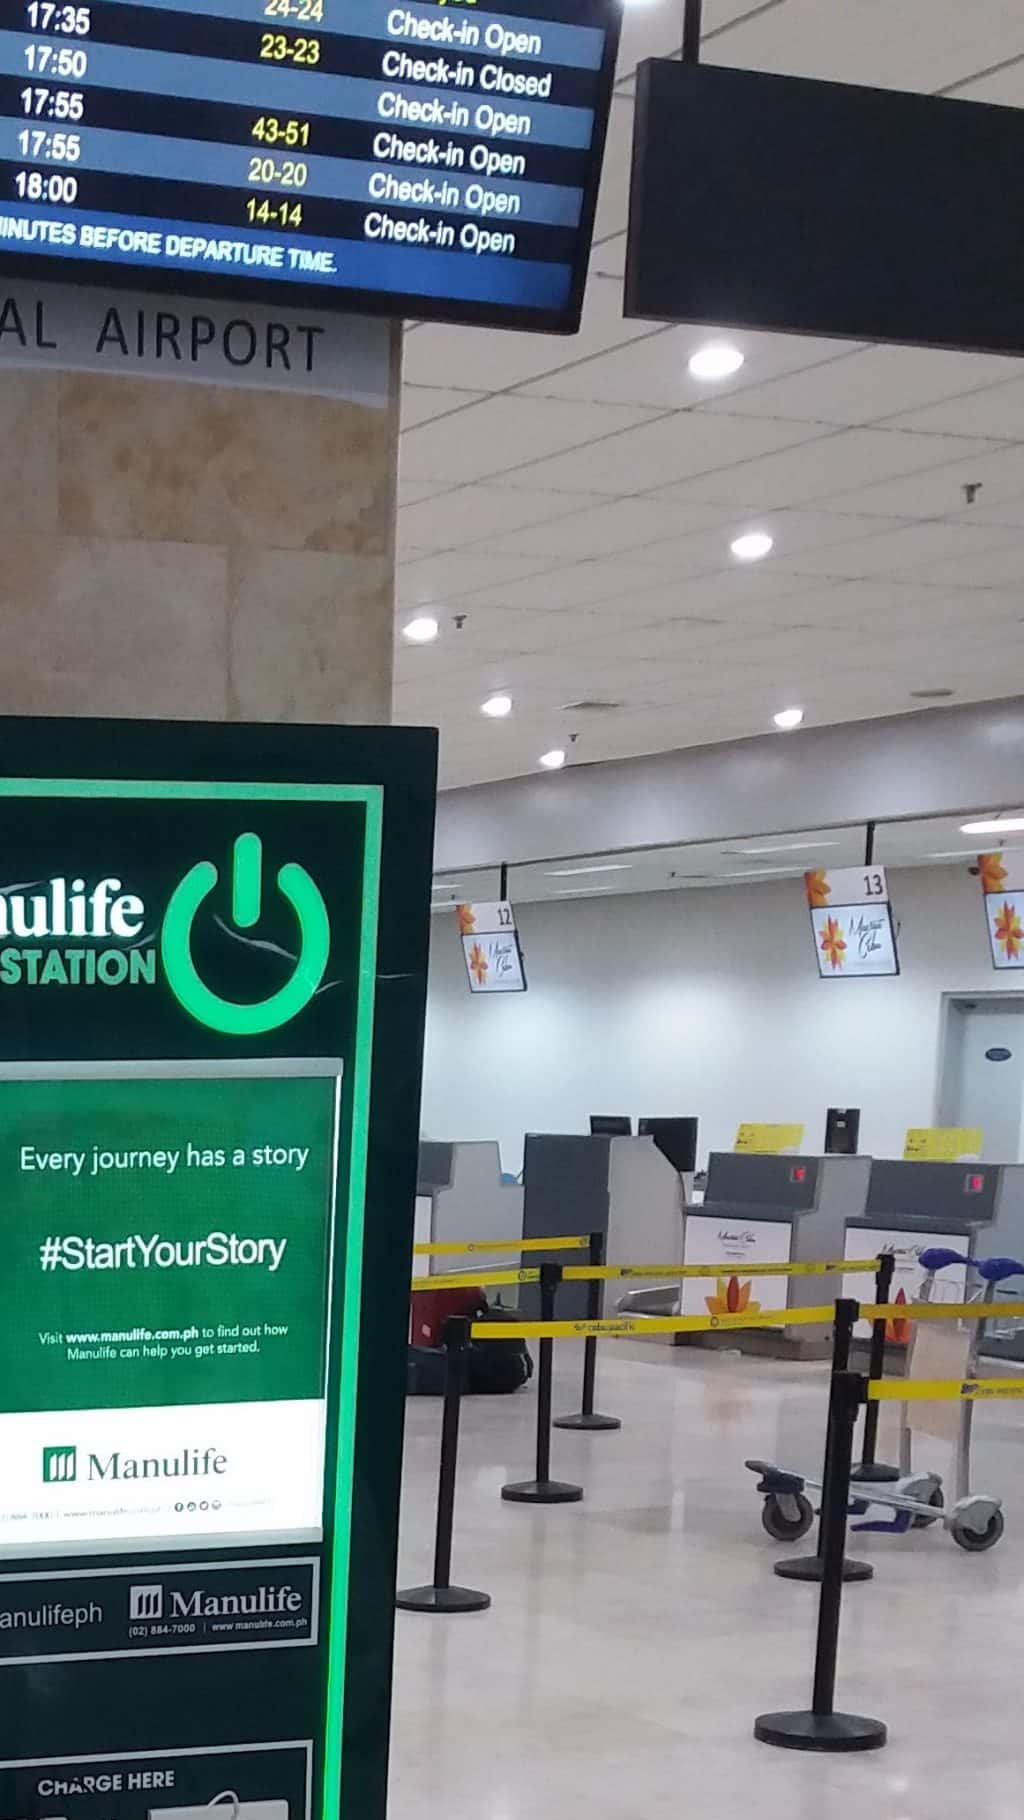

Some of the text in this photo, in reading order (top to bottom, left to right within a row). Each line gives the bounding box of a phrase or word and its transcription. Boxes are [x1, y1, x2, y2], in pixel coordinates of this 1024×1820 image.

[264, 0, 542, 56] 24-24 Check-in Open
[27, 1, 553, 98] 17:35 23-23 Check-in Closed
[24, 43, 87, 79] 17:50
[377, 91, 469, 127] Check-in
[475, 104, 532, 136] Open
[20, 86, 85, 121] 17:55
[251, 116, 310, 147] 43-51
[372, 132, 465, 167] Check-in
[469, 144, 526, 176] Open
[18, 128, 81, 162] 17:55
[247, 156, 308, 188] 20-20
[368, 172, 460, 207] Check-in
[464, 184, 521, 216] Open
[14, 170, 78, 204] 18:00
[245, 197, 303, 227] 14-14
[363, 212, 455, 246] Check-in
[459, 223, 516, 256] Open
[79, 224, 163, 255] BEFORE
[164, 234, 286, 267] DEPARTURE
[287, 247, 337, 273] TIME.
[95, 306, 326, 372] AIRPORT
[863, 874, 884, 897] 13
[497, 907, 513, 926] 12
[20, 1143, 310, 1176] Every journey has a story
[39, 1231, 287, 1272] #StartYourStory
[38, 1323, 289, 1346] Visit www.manulife.com.ph to find out how
[67, 1340, 261, 1361] Manulife can help you get started.
[87, 1447, 228, 1481] Manulife
[169, 1586, 303, 1618] Manulife
[128, 1625, 148, 1638] (02)
[150, 1623, 196, 1636] 884-7000
[37, 1770, 175, 1797] CHARGE HERE
